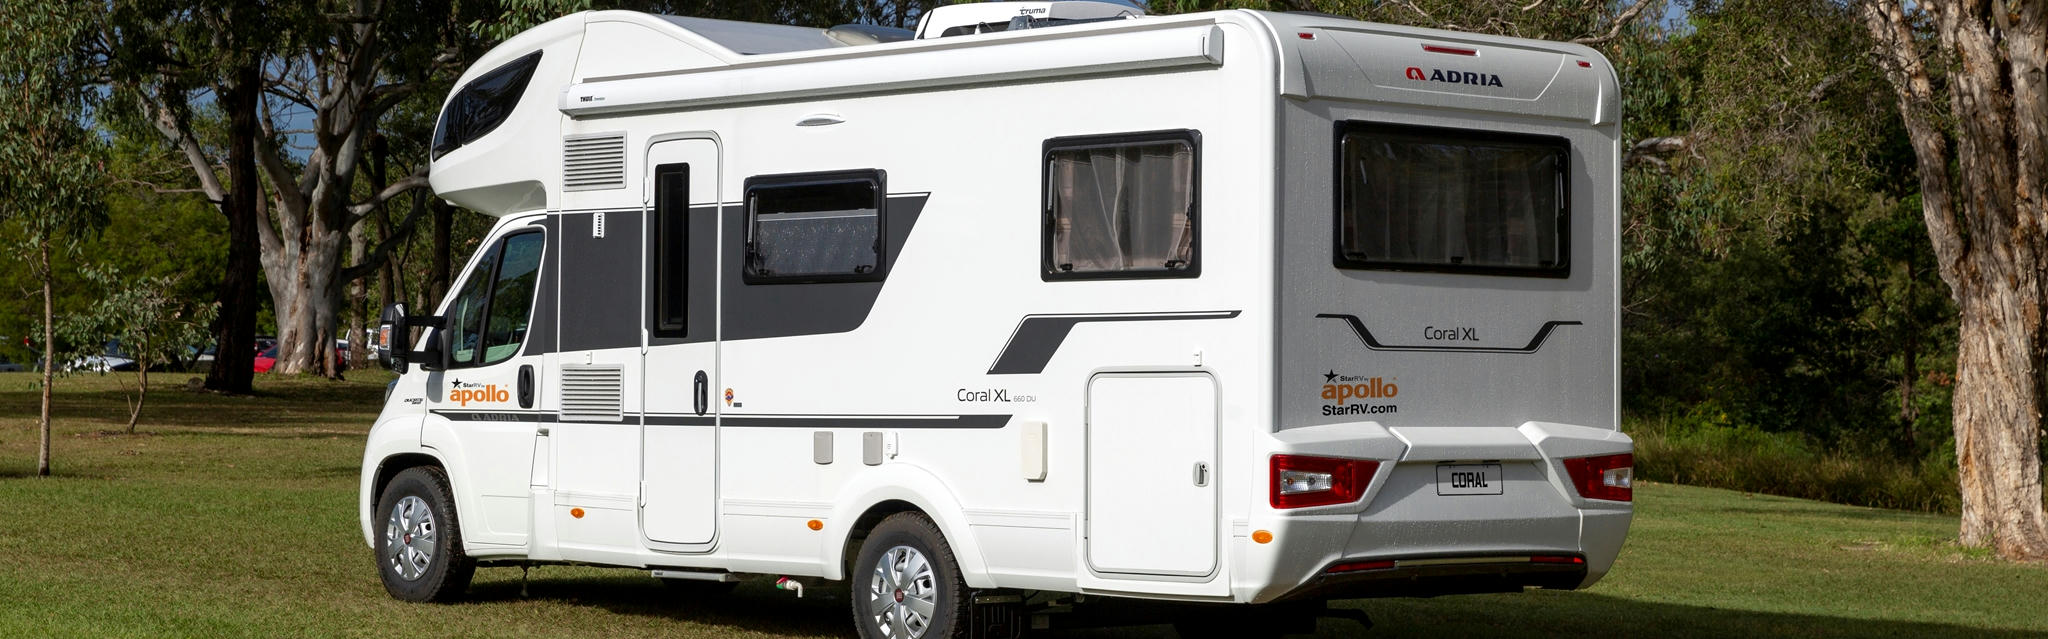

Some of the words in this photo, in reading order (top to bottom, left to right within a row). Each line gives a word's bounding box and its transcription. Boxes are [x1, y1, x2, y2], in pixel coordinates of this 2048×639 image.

[1020, 7, 1046, 15] truma
[1430, 69, 1503, 88] ADRIA
[1424, 326, 1459, 341] Coral
[1462, 327, 1480, 341] XL
[450, 384, 510, 407] apollo
[957, 388, 991, 402] Coral
[993, 388, 1011, 402] XL
[1013, 395, 1025, 403] 660
[1026, 395, 1036, 403] DU
[1321, 377, 1398, 405] apollo
[483, 413, 520, 421] ADRIA
[1322, 403, 1398, 416] StarRV.com
[1451, 471, 1488, 488] CORAL
